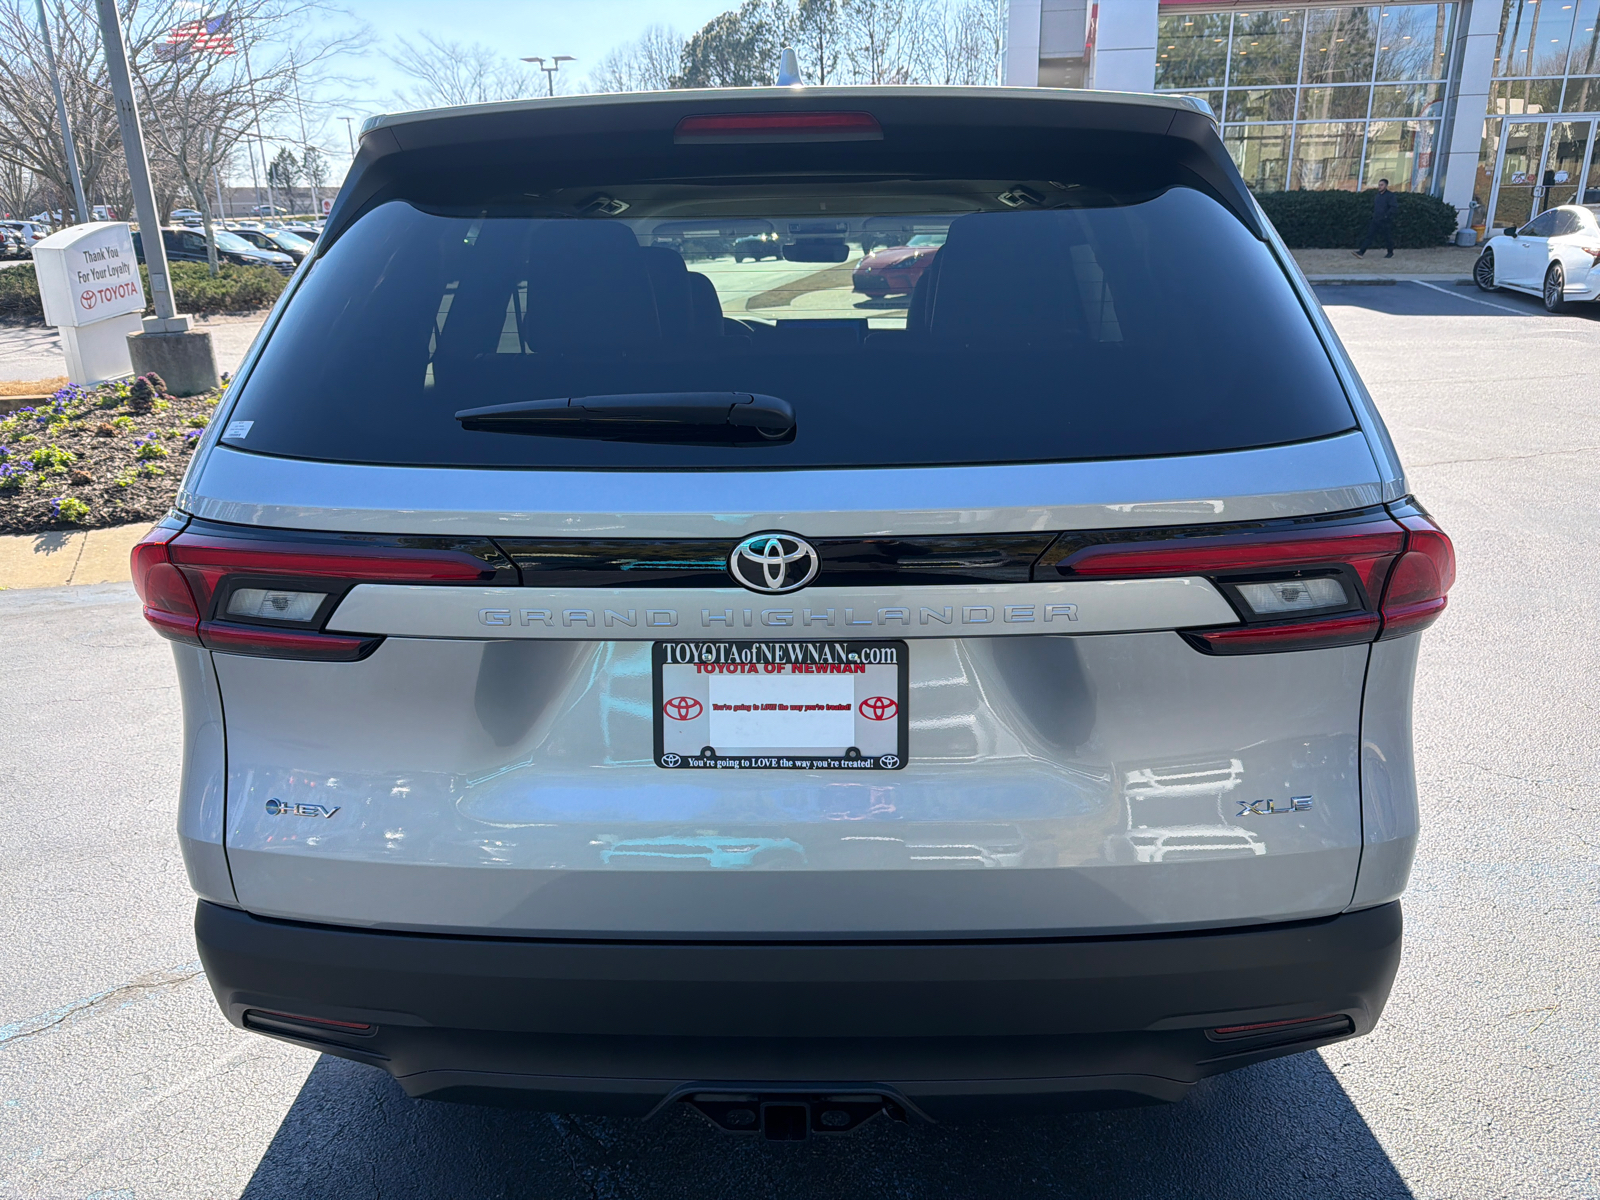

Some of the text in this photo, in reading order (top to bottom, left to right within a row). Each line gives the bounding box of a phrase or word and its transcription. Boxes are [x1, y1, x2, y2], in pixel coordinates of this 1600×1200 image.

[83, 246, 119, 264] Thank You
[77, 262, 131, 284] For Your Loyalty
[97, 281, 138, 303] TOYOTA
[478, 604, 1080, 628] GRAND HIGHLANDER
[694, 663, 866, 674] TOYOTA OF NEWNAN
[733, 704, 752, 712] going
[804, 704, 825, 712] you're
[688, 757, 874, 769] You're going to LOVE the way you're treated!
[1236, 795, 1313, 817] XLE
